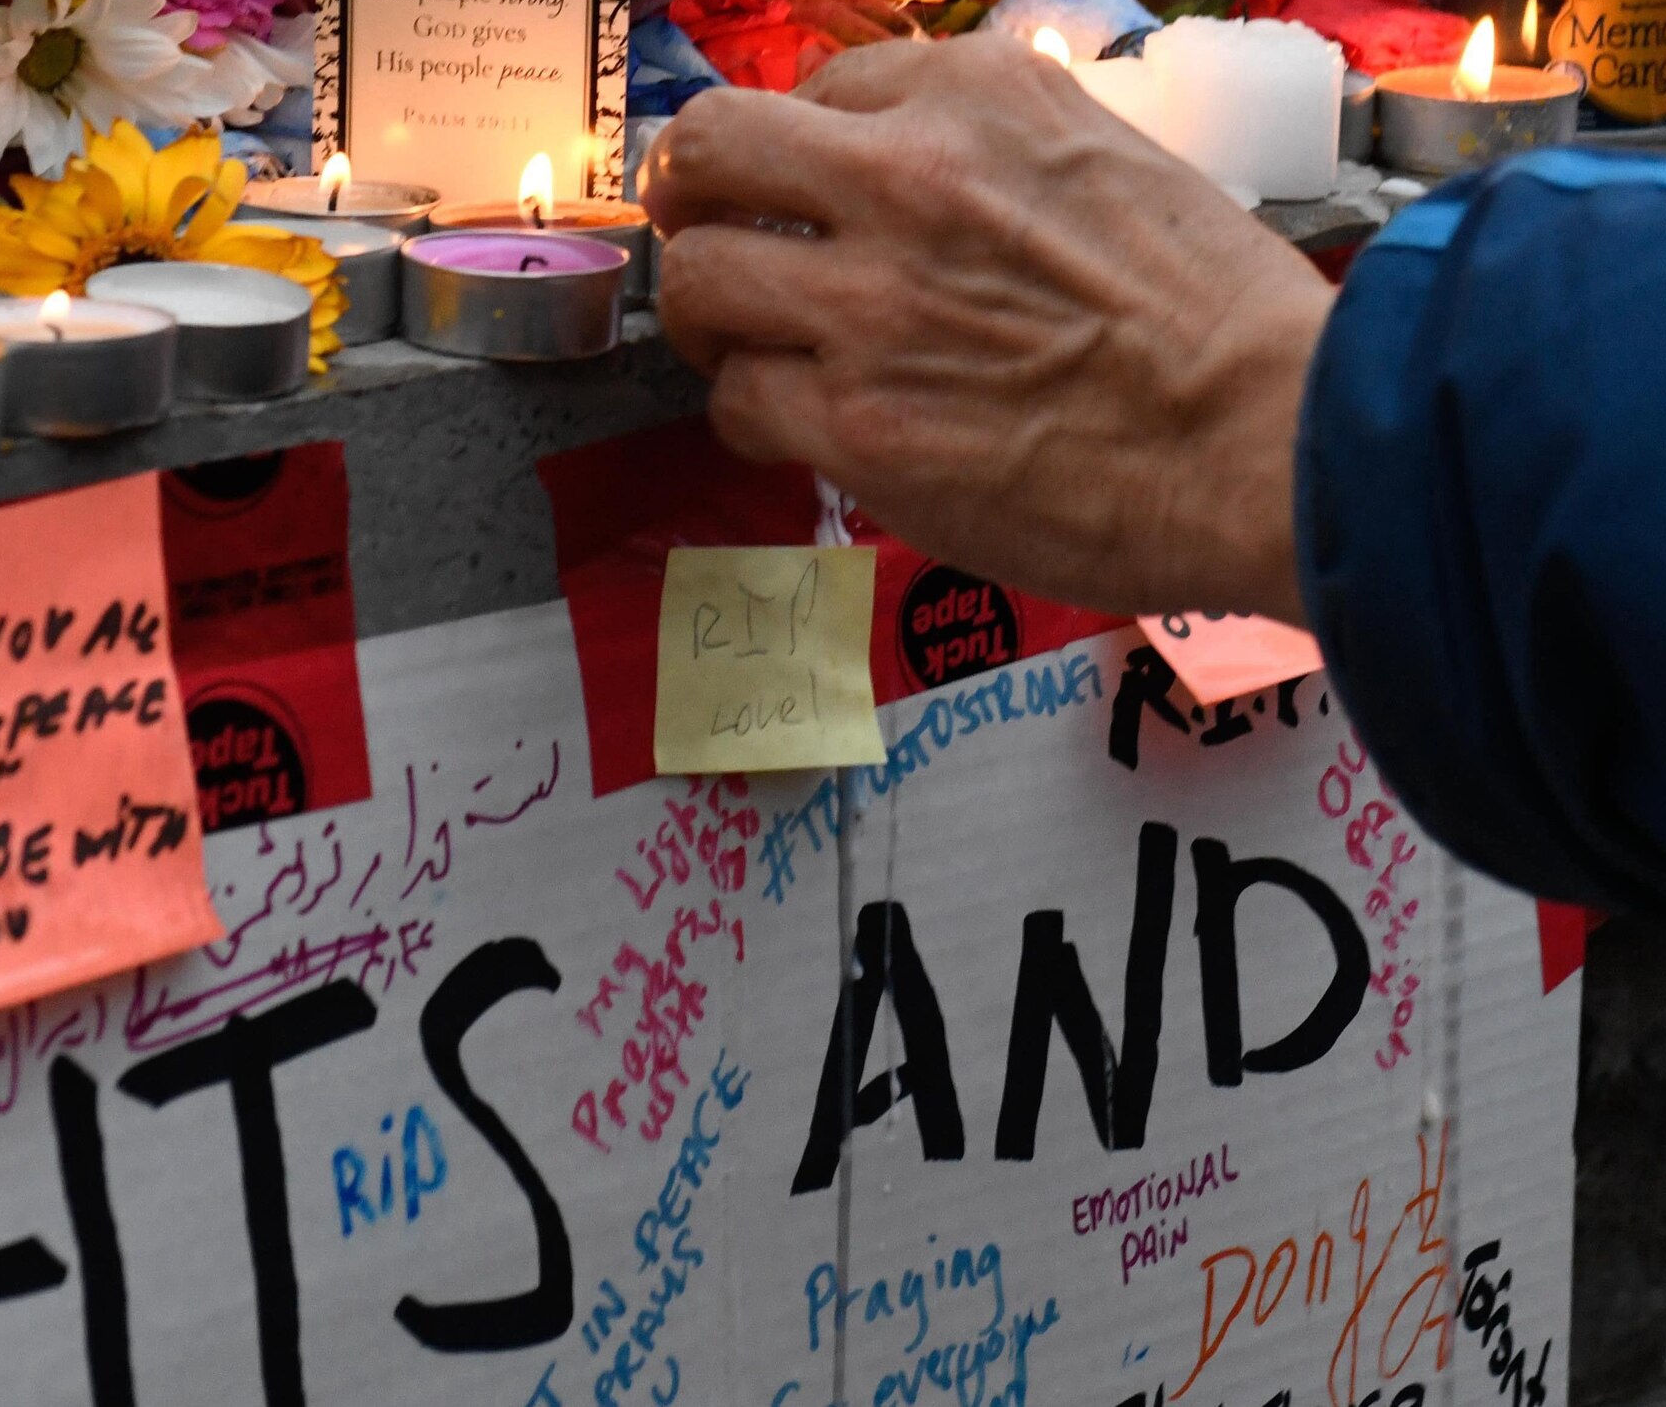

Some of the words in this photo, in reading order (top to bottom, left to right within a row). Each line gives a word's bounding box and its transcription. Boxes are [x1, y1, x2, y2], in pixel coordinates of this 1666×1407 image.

[472, 19, 527, 47] gives
[375, 50, 414, 74] His
[420, 52, 493, 81] people
[691, 557, 820, 659] RIP
[911, 582, 1002, 632] Tape
[923, 622, 1010, 677] Tuck
[757, 651, 1104, 906] #TOONTOSTRONG
[789, 820, 1373, 1197] AND
